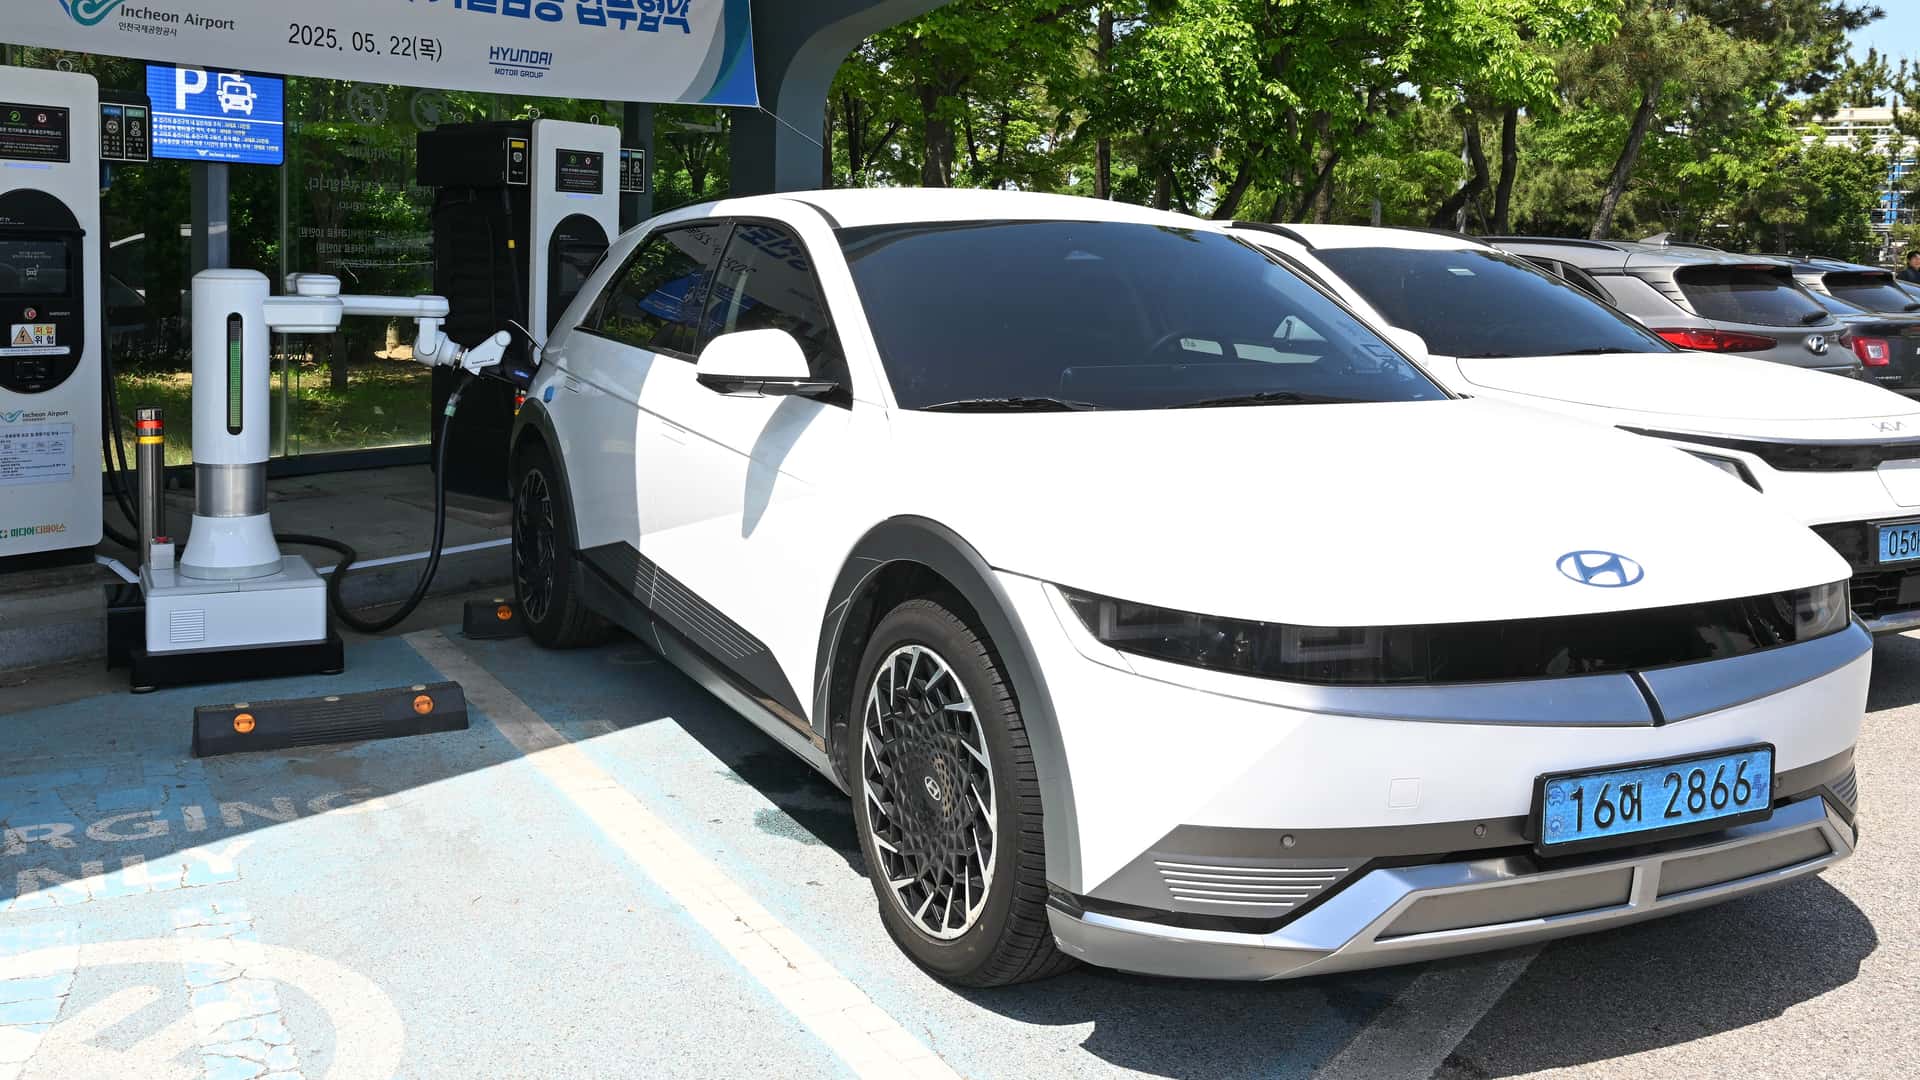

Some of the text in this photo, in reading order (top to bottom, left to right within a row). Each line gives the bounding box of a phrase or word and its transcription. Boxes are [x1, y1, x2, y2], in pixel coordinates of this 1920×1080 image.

[120, 4, 235, 30] Incheon Airport
[288, 23, 442, 63] 2025. 05. 22(목)
[490, 45, 552, 65] HYUNDAI
[495, 67, 544, 78] MOTOR GROUP
[175, 68, 208, 111] P
[1663, 759, 1752, 819] 2866
